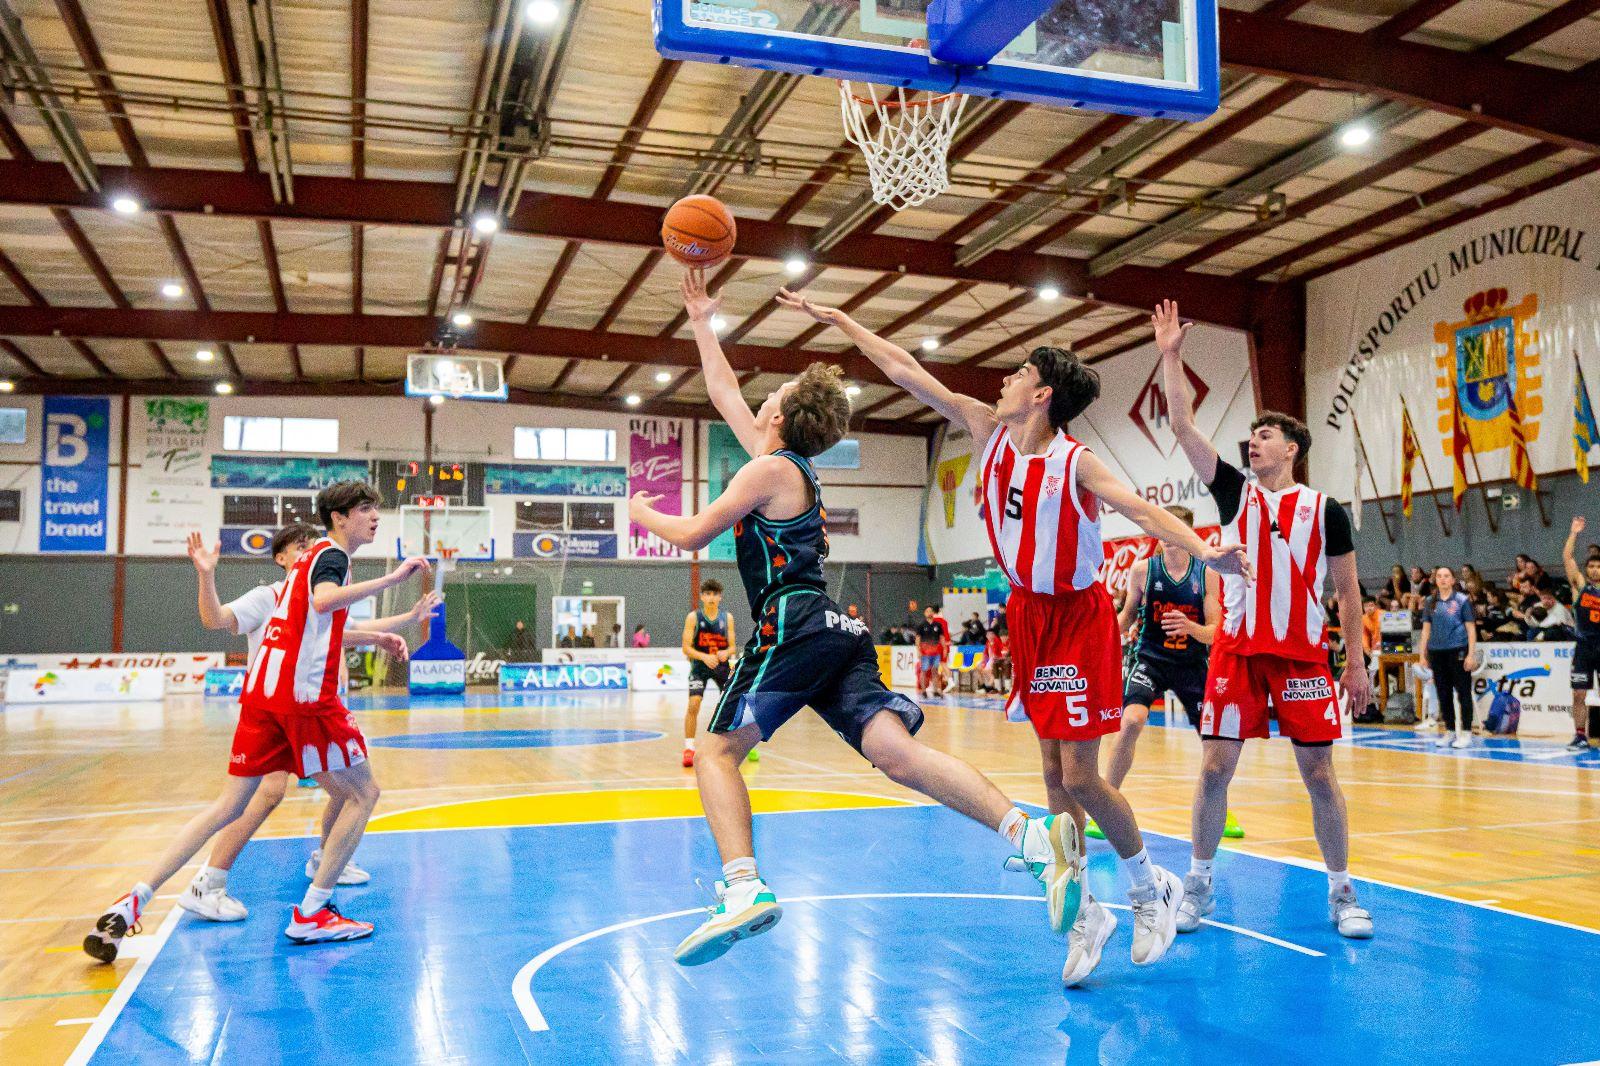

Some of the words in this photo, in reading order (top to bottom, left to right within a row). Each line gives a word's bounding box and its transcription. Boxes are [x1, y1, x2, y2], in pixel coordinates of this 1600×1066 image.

[1326, 263, 1441, 432] POLIESPORTIU
[1448, 224, 1585, 277] MUNICIPAL
[46, 412, 89, 467] B
[46, 477, 78, 494] the
[572, 481, 624, 496] ALAIOR
[45, 498, 99, 516] travel
[1005, 486, 1023, 521] 5
[45, 520, 103, 538] brand
[1489, 648, 1541, 658] SERVICIO
[413, 663, 463, 675] ALAIOR
[522, 665, 623, 688] ALAIOR
[1287, 677, 1327, 689] BENITO
[1474, 675, 1537, 702] extra
[1065, 694, 1089, 727] 5
[1324, 701, 1338, 726] 4
